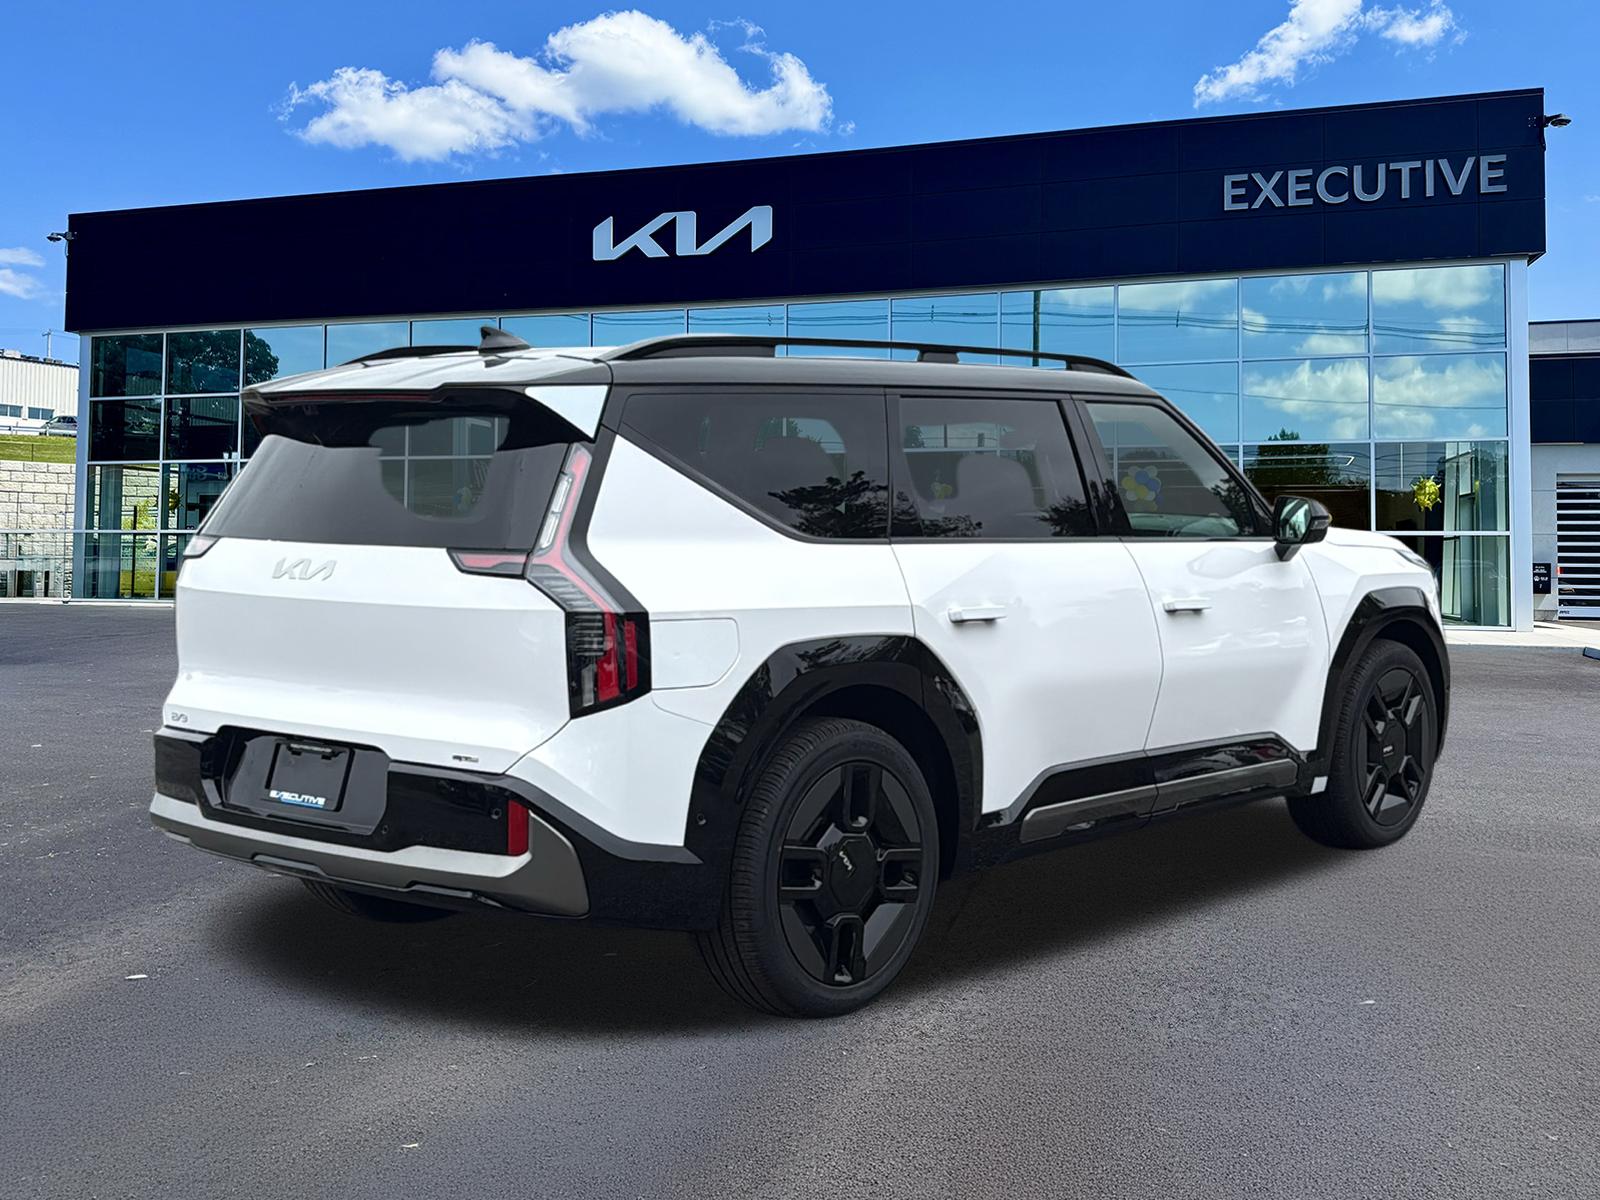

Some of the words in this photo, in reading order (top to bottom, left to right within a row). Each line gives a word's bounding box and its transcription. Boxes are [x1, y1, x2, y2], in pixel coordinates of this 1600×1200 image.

[1223, 154, 1508, 212] EXECUTIVE
[593, 205, 773, 261] KIA
[272, 557, 337, 581] KIA
